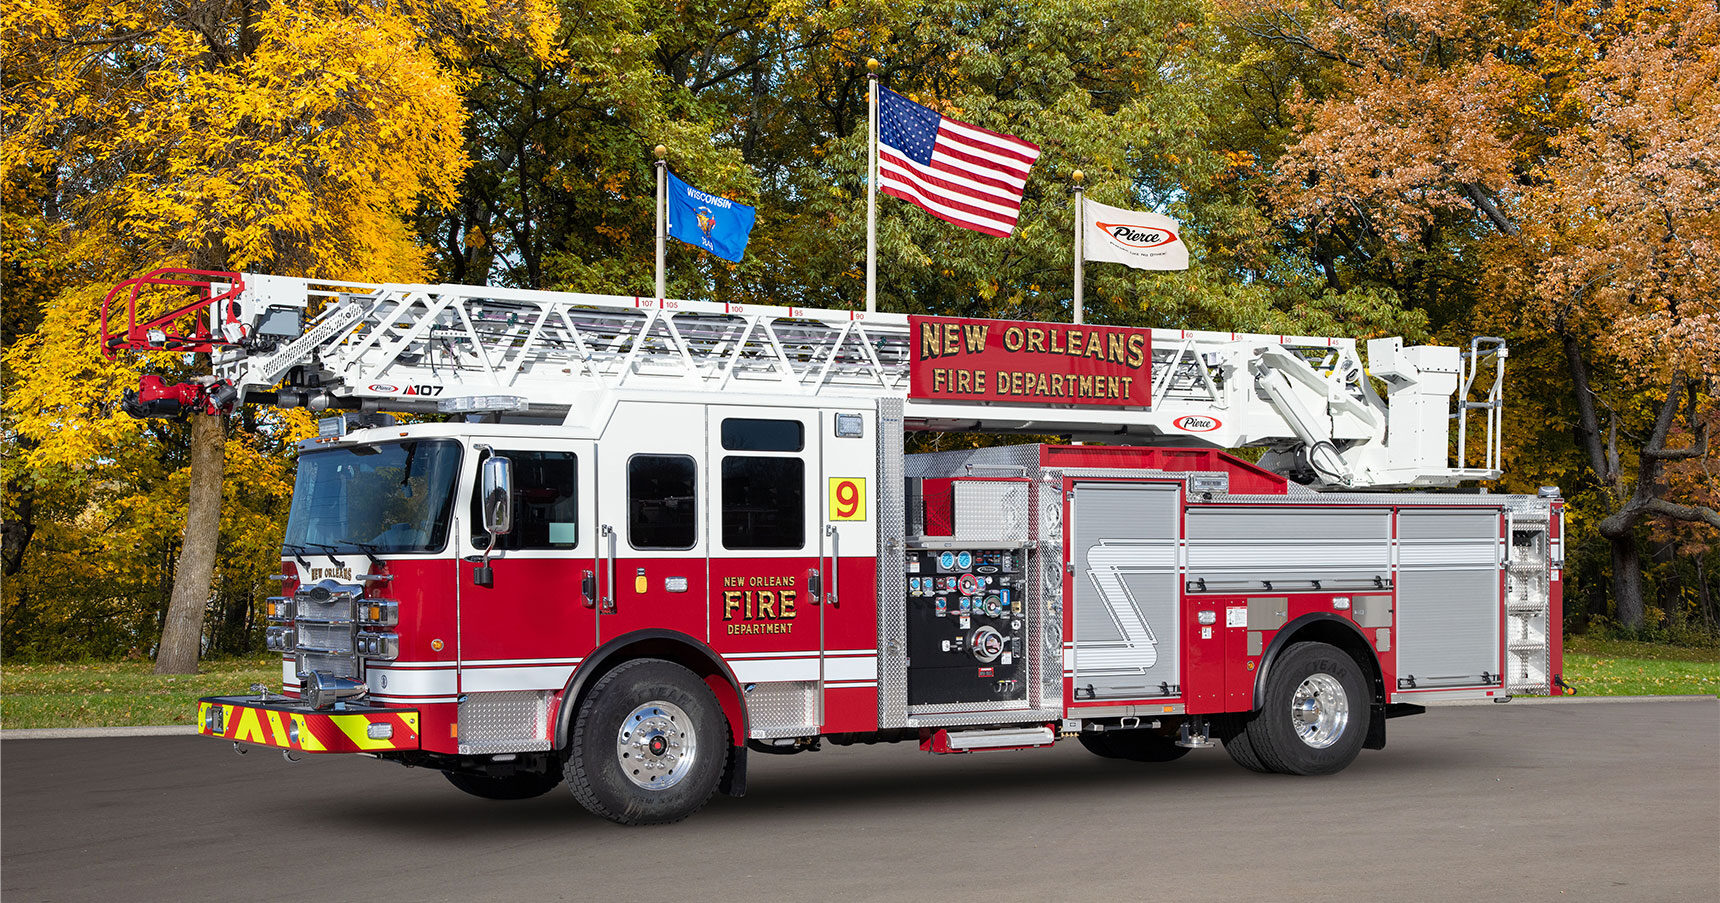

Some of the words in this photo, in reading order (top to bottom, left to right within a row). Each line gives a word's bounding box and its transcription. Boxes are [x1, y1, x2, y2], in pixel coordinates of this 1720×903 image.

[687, 187, 732, 209] WISCONSIN
[1113, 226, 1161, 243] Pierce
[920, 322, 990, 360] NEW
[1003, 326, 1145, 369] ORLEANS
[932, 368, 986, 394] FIRE
[997, 371, 1133, 399] DEPARTMENT
[1183, 417, 1211, 428] Pierce
[836, 480, 859, 518] 9
[311, 567, 323, 581] NEW
[324, 567, 352, 581] ORLEANS
[724, 576, 745, 587] NEW
[749, 576, 795, 587] ORLEANS
[722, 590, 797, 621] FIRE
[727, 623, 793, 635] DEPARTMENT
